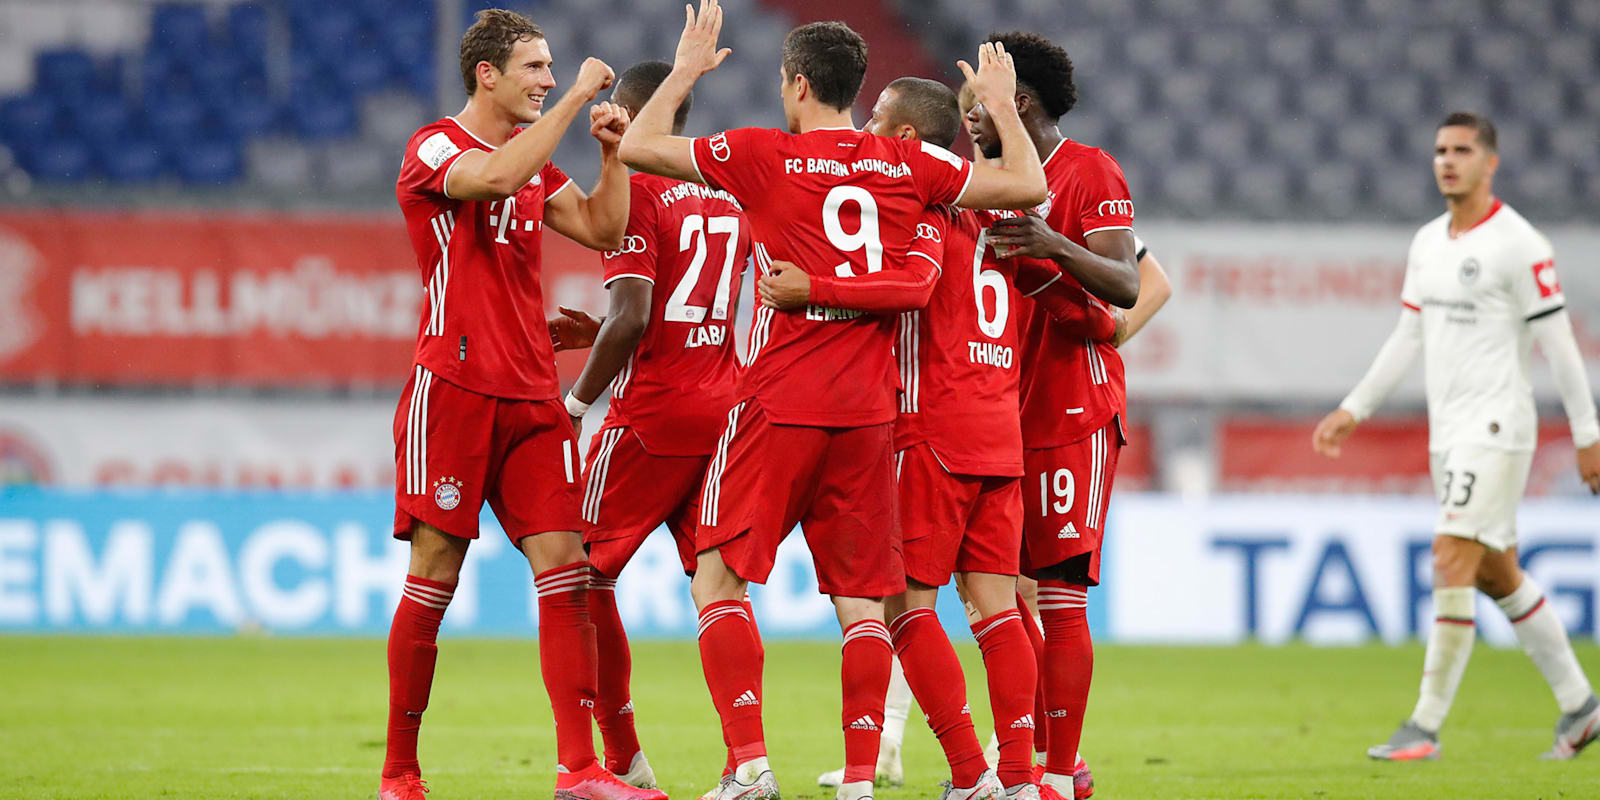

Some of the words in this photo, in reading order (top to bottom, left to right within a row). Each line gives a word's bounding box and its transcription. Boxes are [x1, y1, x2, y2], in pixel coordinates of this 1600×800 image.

[785, 158, 804, 174] FC
[806, 158, 850, 177] BAYERN
[660, 190, 675, 207] FC
[822, 185, 884, 278] 9
[664, 214, 740, 323] 27
[972, 227, 1009, 338] 6
[968, 341, 1013, 369] THIGO
[1040, 468, 1075, 517] 19
[1440, 471, 1476, 507] 33
[733, 699, 759, 708] adidas
[850, 723, 878, 732] adidas
[1010, 722, 1035, 731] adidas
